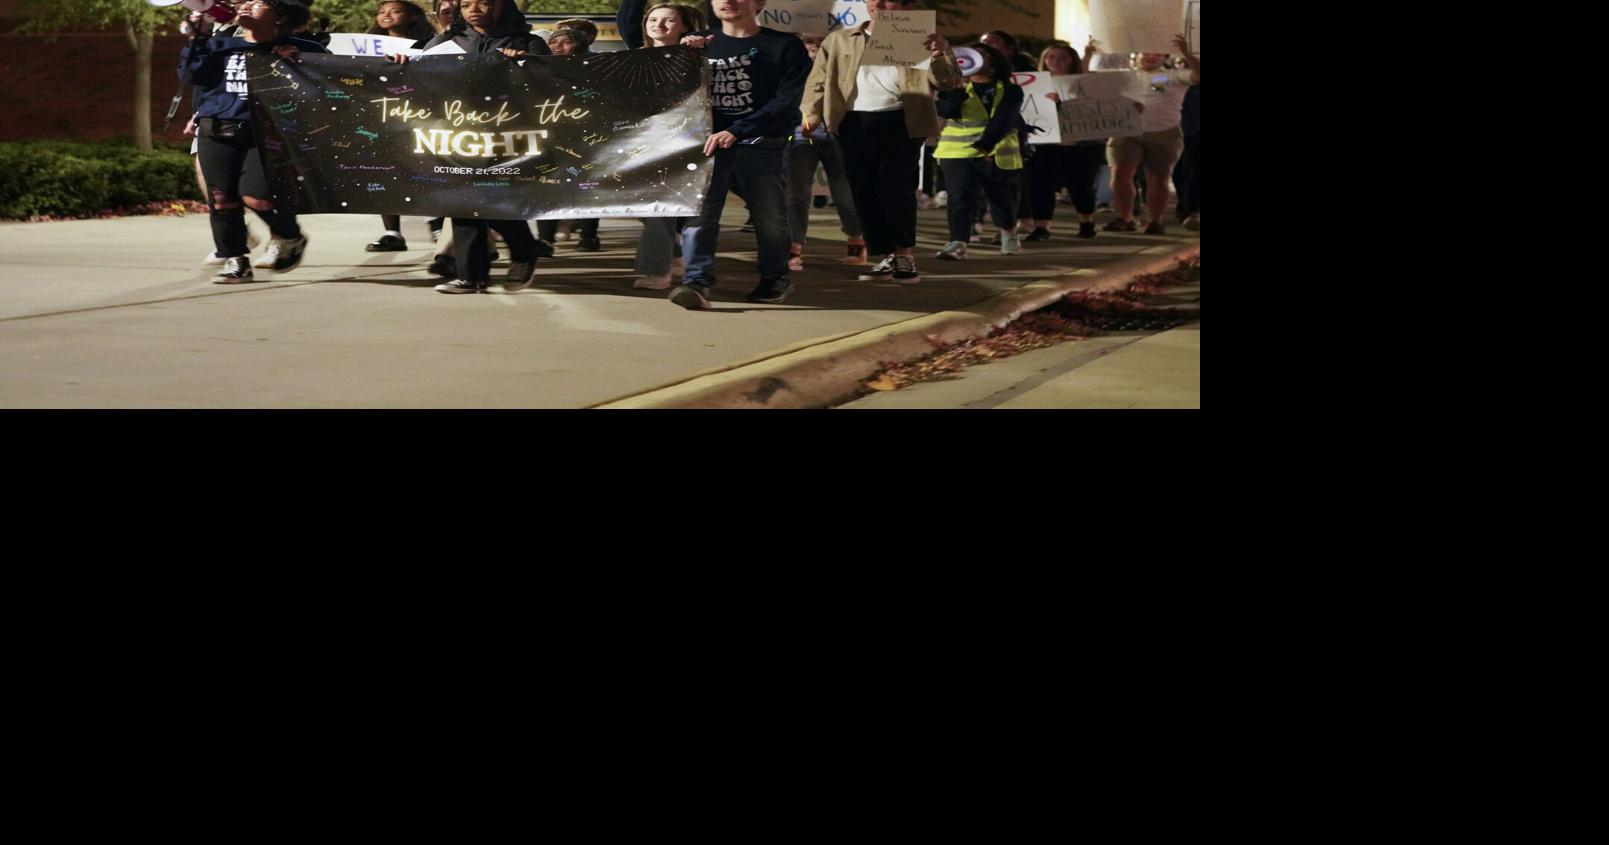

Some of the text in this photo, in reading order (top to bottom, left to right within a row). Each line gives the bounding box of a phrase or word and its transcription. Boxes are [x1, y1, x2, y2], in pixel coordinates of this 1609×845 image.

[763, 9, 791, 25] NO
[352, 38, 385, 55] WE
[712, 68, 751, 81] ACK
[711, 81, 737, 93] HE
[370, 94, 590, 127] Take Back the
[412, 127, 549, 158] NIGHT
[433, 165, 474, 176] OCTOBER
[490, 166, 521, 175] 2022
